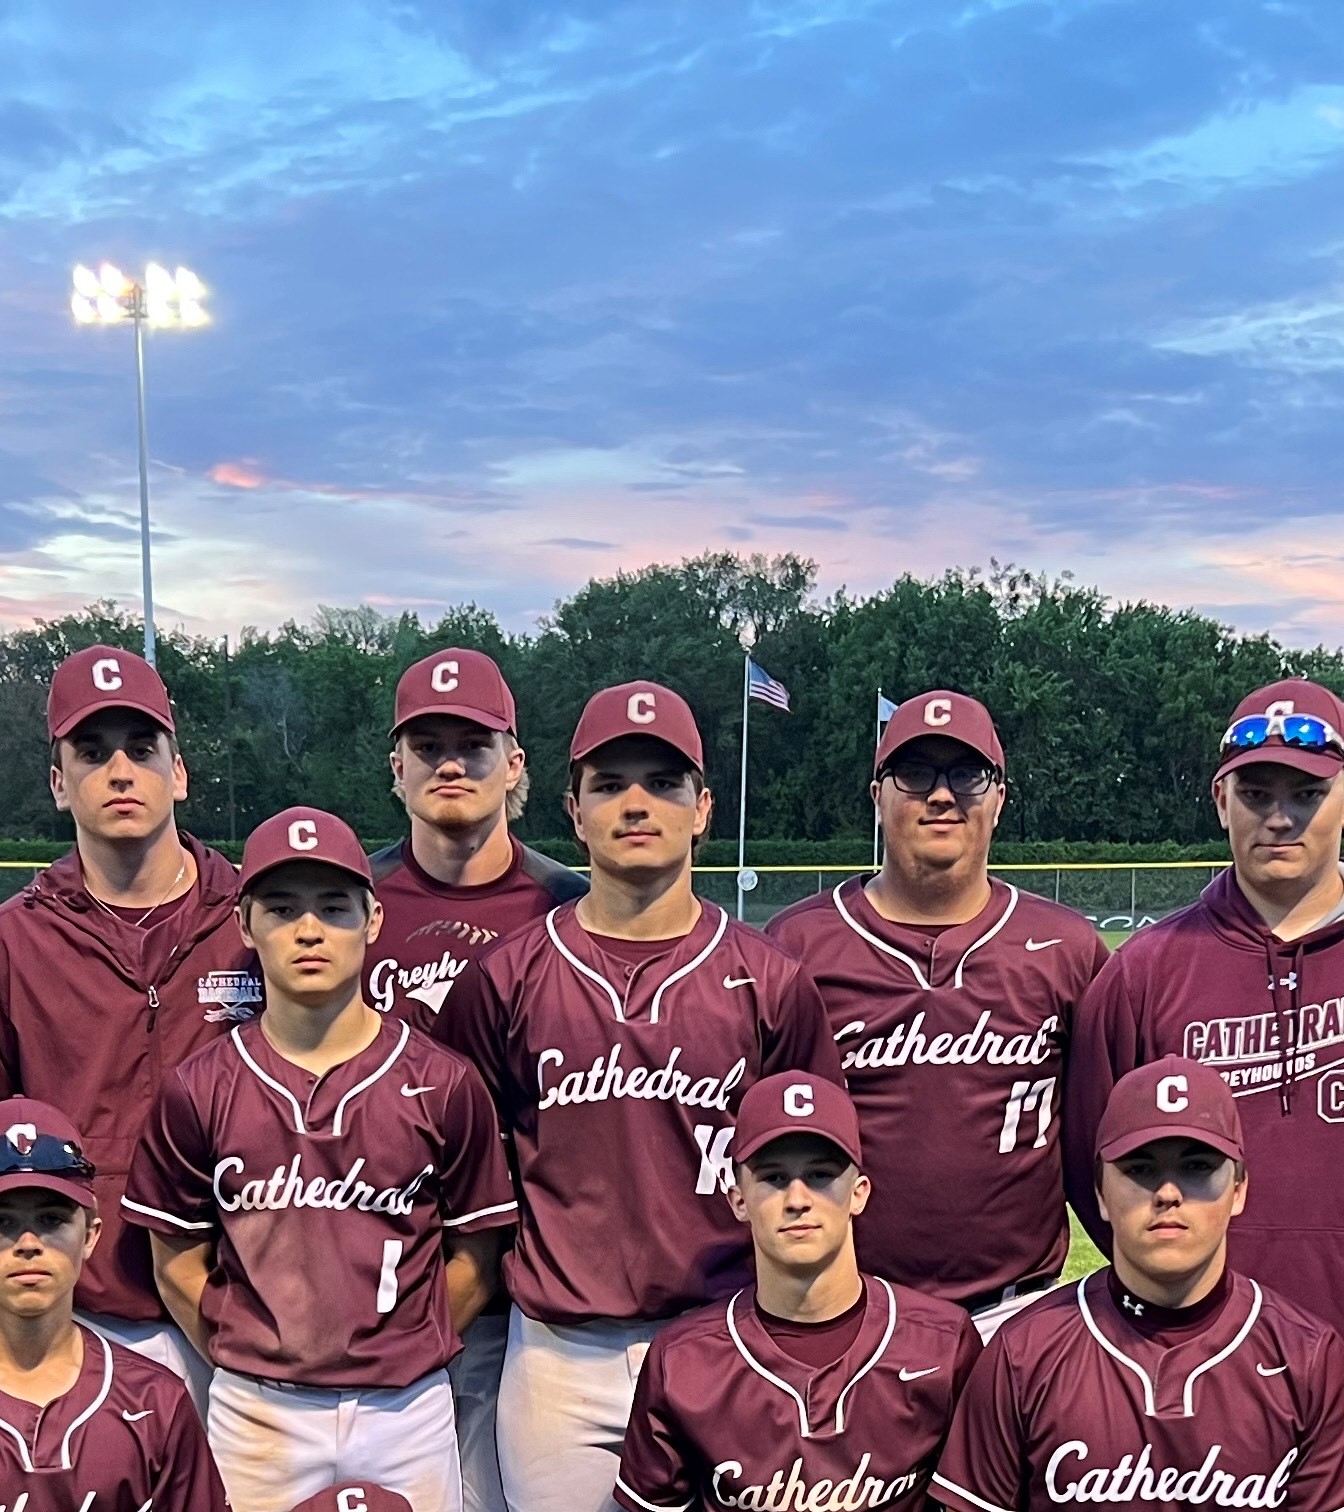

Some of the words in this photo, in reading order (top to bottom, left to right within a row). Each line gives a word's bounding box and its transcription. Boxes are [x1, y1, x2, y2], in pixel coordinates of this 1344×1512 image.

[92, 659, 123, 692] C
[430, 661, 459, 692] C
[625, 693, 656, 725] C
[922, 699, 953, 727] C
[287, 819, 319, 851] C
[198, 977, 262, 987] CATHEDRAL
[537, 1043, 747, 1111] Cathedral
[1156, 1075, 1189, 1113] C
[783, 1084, 815, 1117] C
[998, 1076, 1057, 1154] 17
[693, 1124, 736, 1195] 16
[213, 1154, 434, 1216] Cathedral
[376, 1239, 403, 1314] 1
[1045, 1441, 1298, 1509] Cathedral
